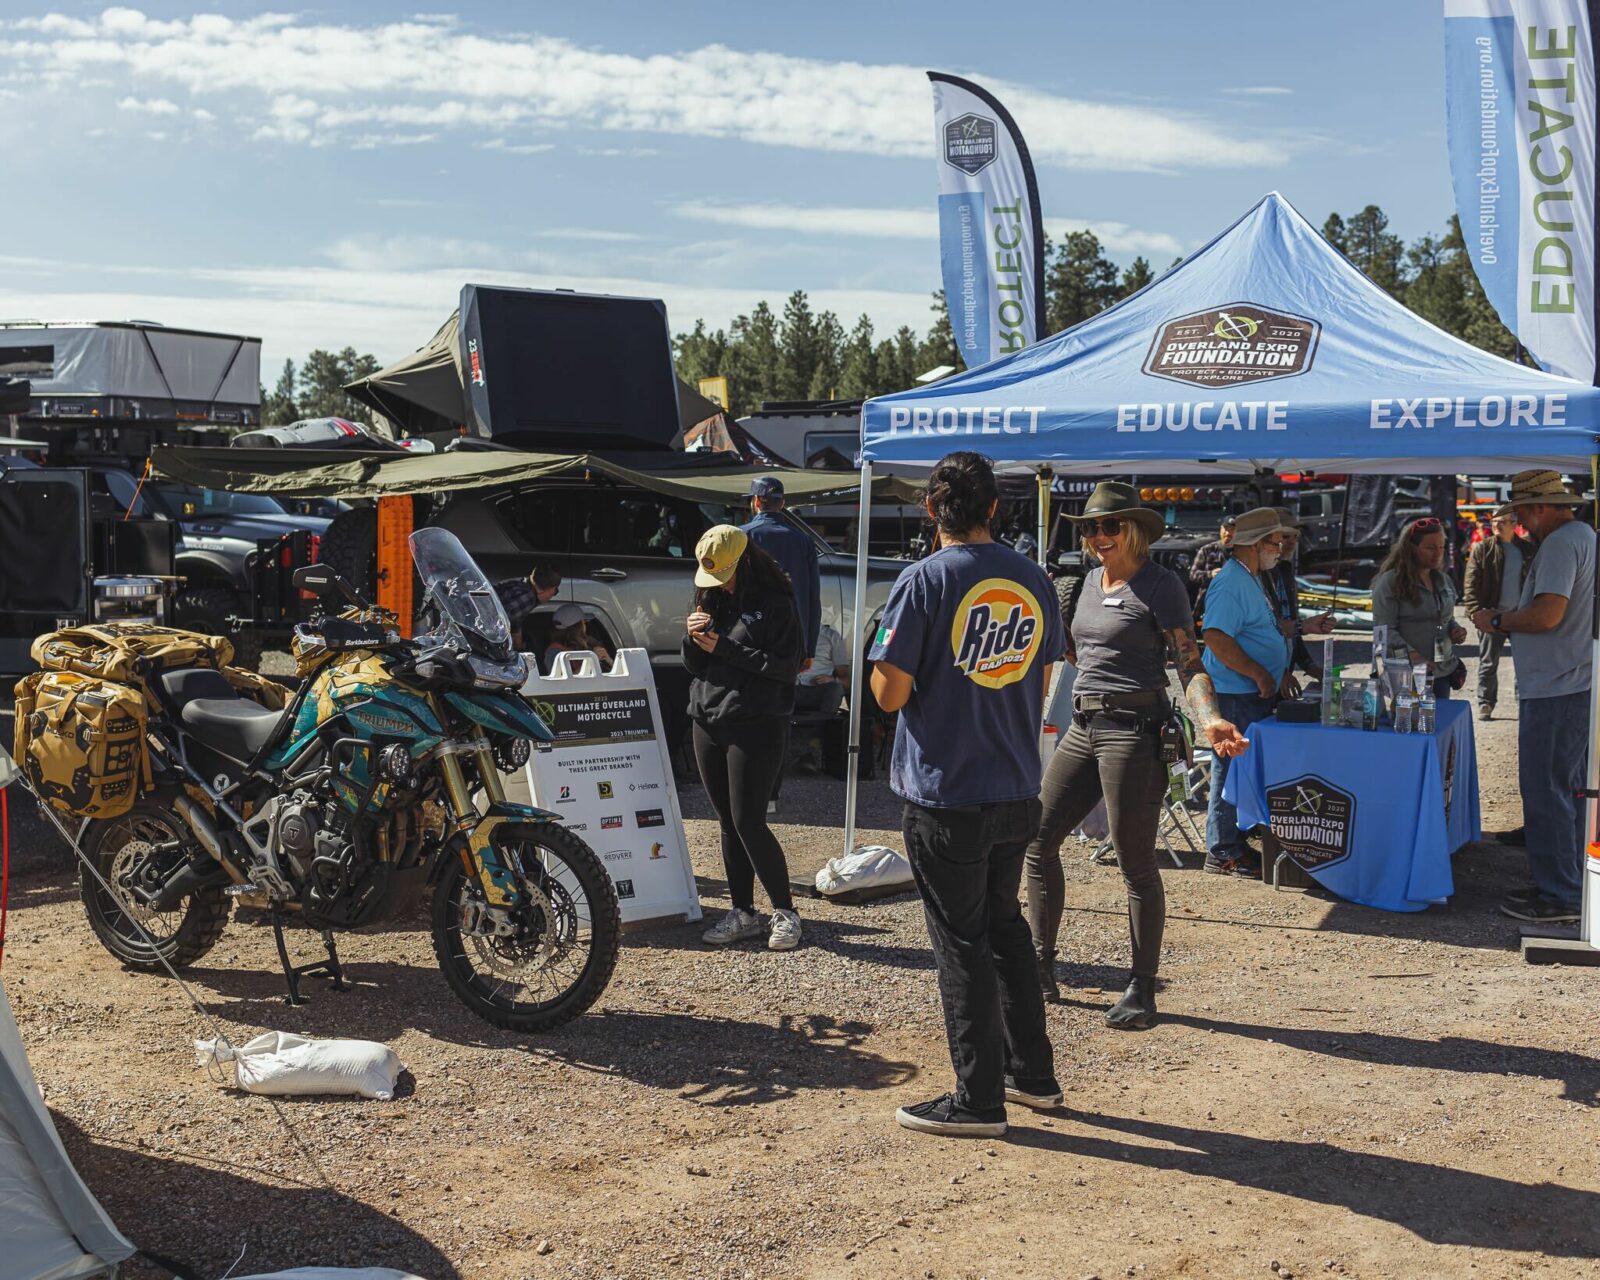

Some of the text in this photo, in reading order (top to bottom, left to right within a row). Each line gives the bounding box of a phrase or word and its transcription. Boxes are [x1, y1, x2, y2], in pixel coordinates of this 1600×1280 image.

[1166, 341, 1299, 352] OVERLAND EXPO
[1160, 349, 1297, 367] FOUNDATION
[890, 393, 1568, 435] PROTECT EDUCATE EXPLORE
[345, 638, 380, 647] Barkbusters
[954, 602, 1036, 676] Ride
[557, 699, 646, 713] ULTIMATE OVERLAND
[357, 709, 415, 733] TRIUMPH
[577, 710, 632, 722] MOTORCYCLE
[584, 756, 624, 765] PARTNERSHIP
[589, 764, 608, 772] GREAT
[609, 762, 633, 770] BRANDS
[637, 783, 660, 791] Helinox
[1270, 815, 1344, 830] OVERLAND EXPO
[1270, 823, 1343, 848] FOUNDATION
